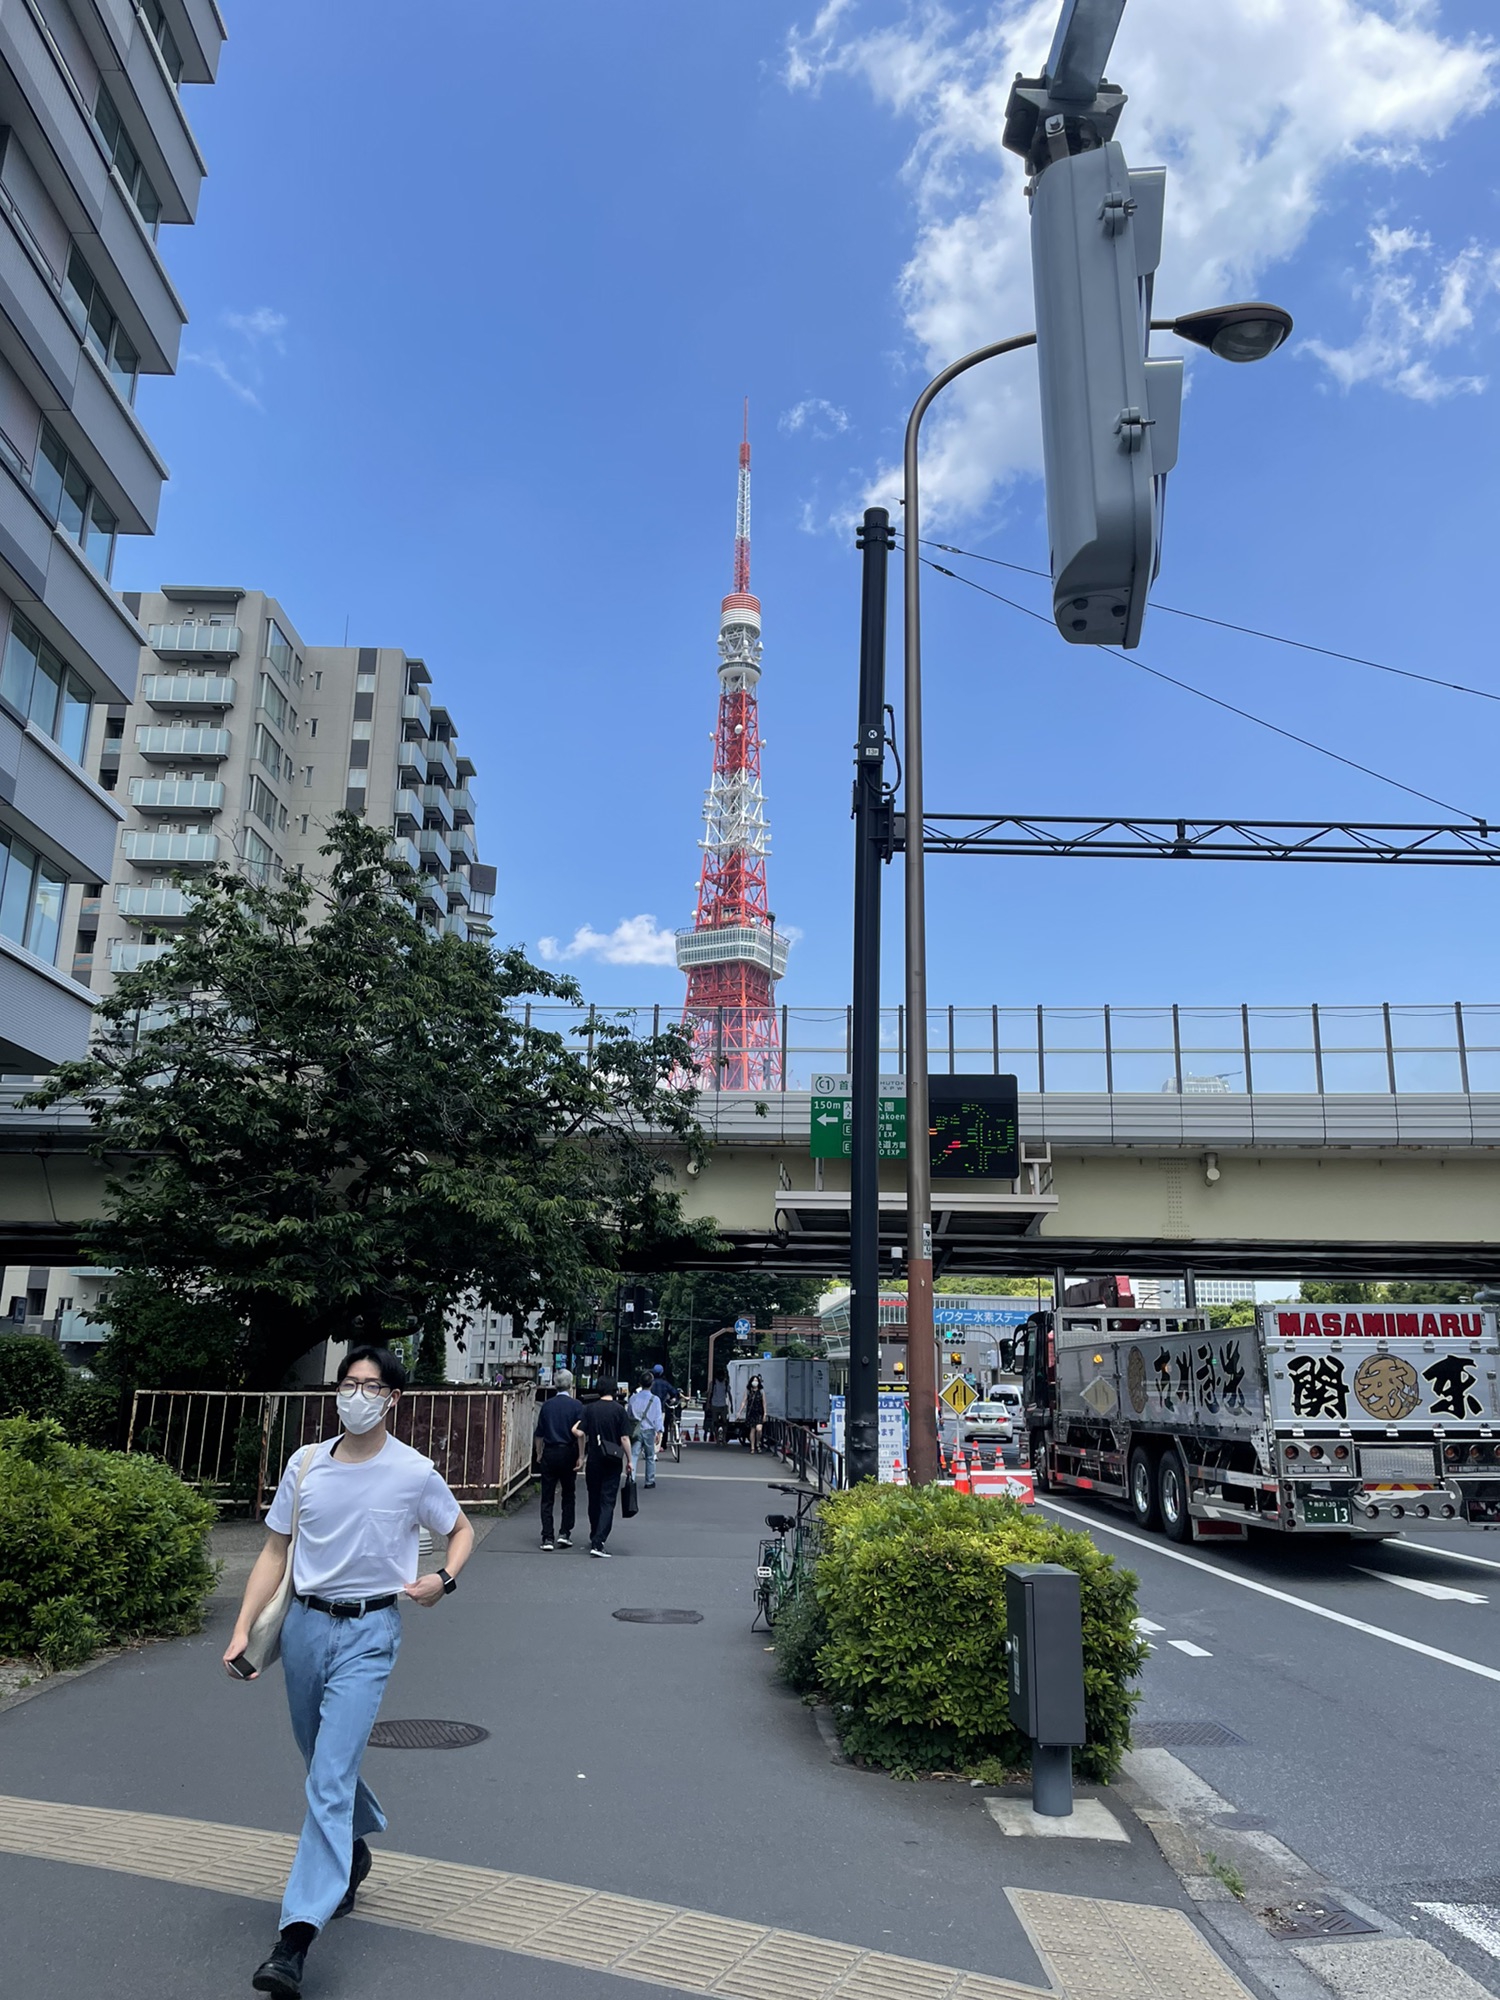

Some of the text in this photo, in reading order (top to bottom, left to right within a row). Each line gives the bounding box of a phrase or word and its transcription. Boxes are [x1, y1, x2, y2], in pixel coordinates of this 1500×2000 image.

[814, 1101, 841, 1109] 150m
[880, 1112, 905, 1120] akoen
[1278, 1312, 1484, 1337] MASAMIMARU
